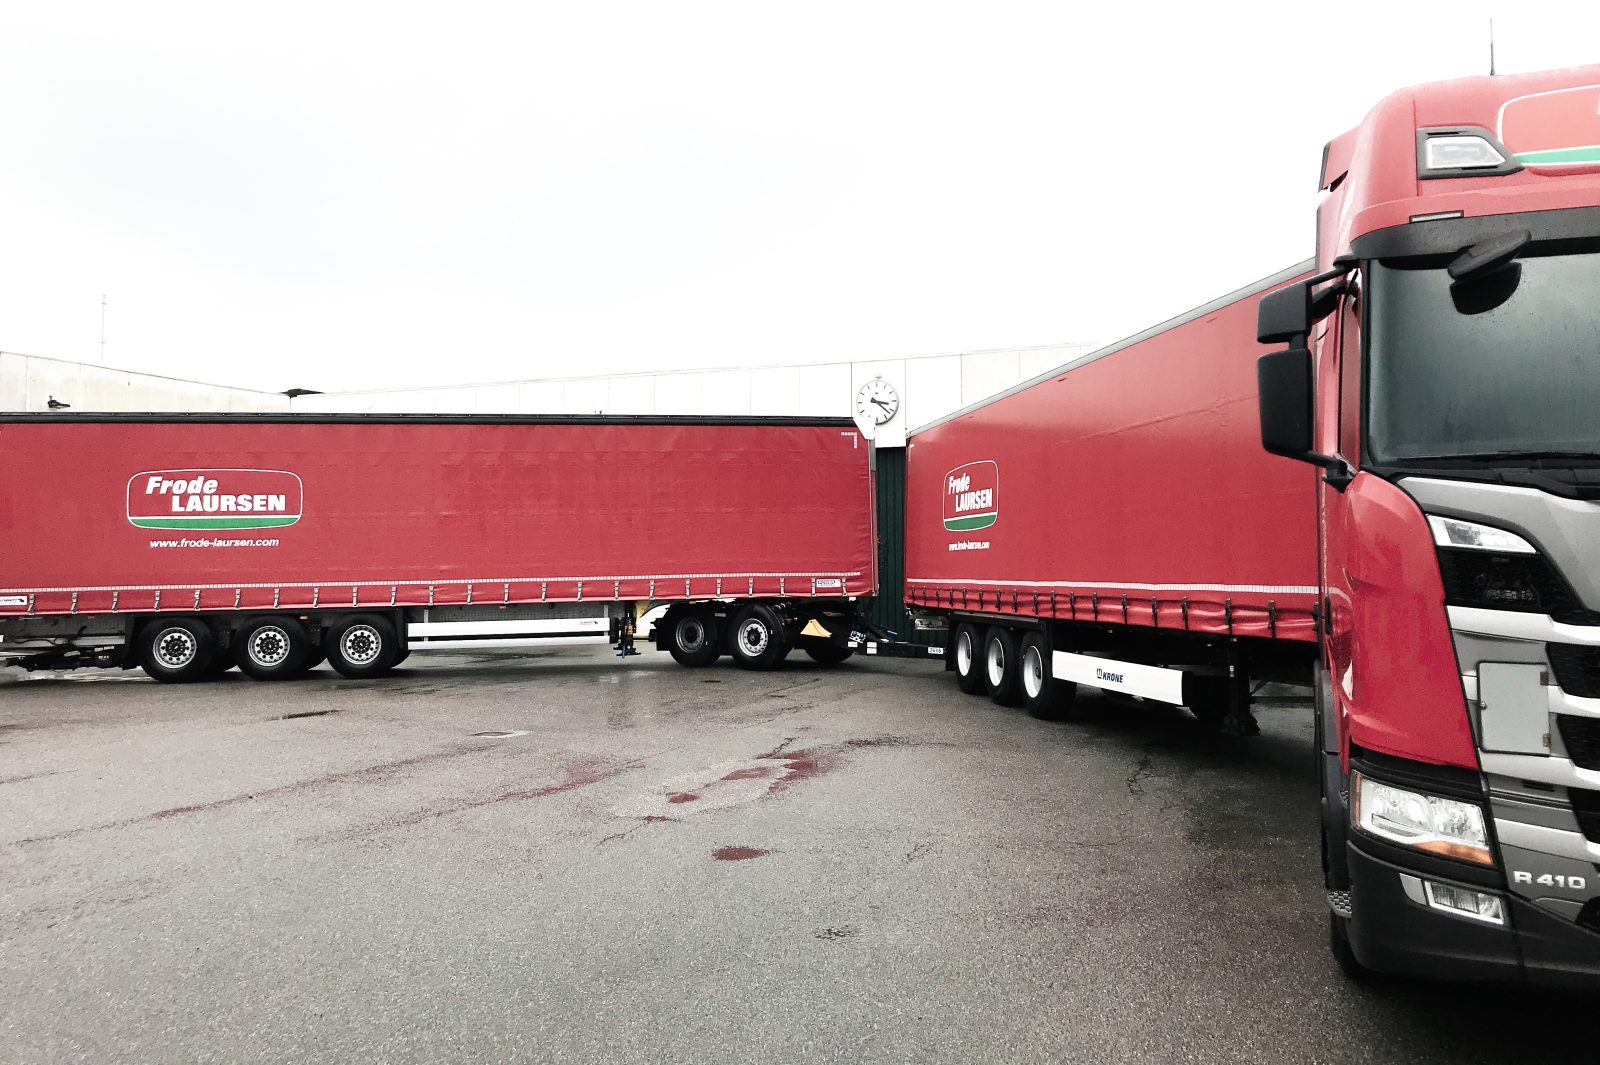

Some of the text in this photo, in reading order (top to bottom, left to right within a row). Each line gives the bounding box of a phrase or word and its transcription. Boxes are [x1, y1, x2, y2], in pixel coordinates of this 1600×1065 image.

[145, 476, 218, 494] Frode
[948, 472, 970, 495] Frode
[171, 494, 286, 512] LAURSEN
[955, 488, 993, 512] LAURSEN
[150, 538, 279, 548] www.frode-laursen.com
[1102, 672, 1123, 683] KRONE
[1513, 870, 1586, 890] R 410
